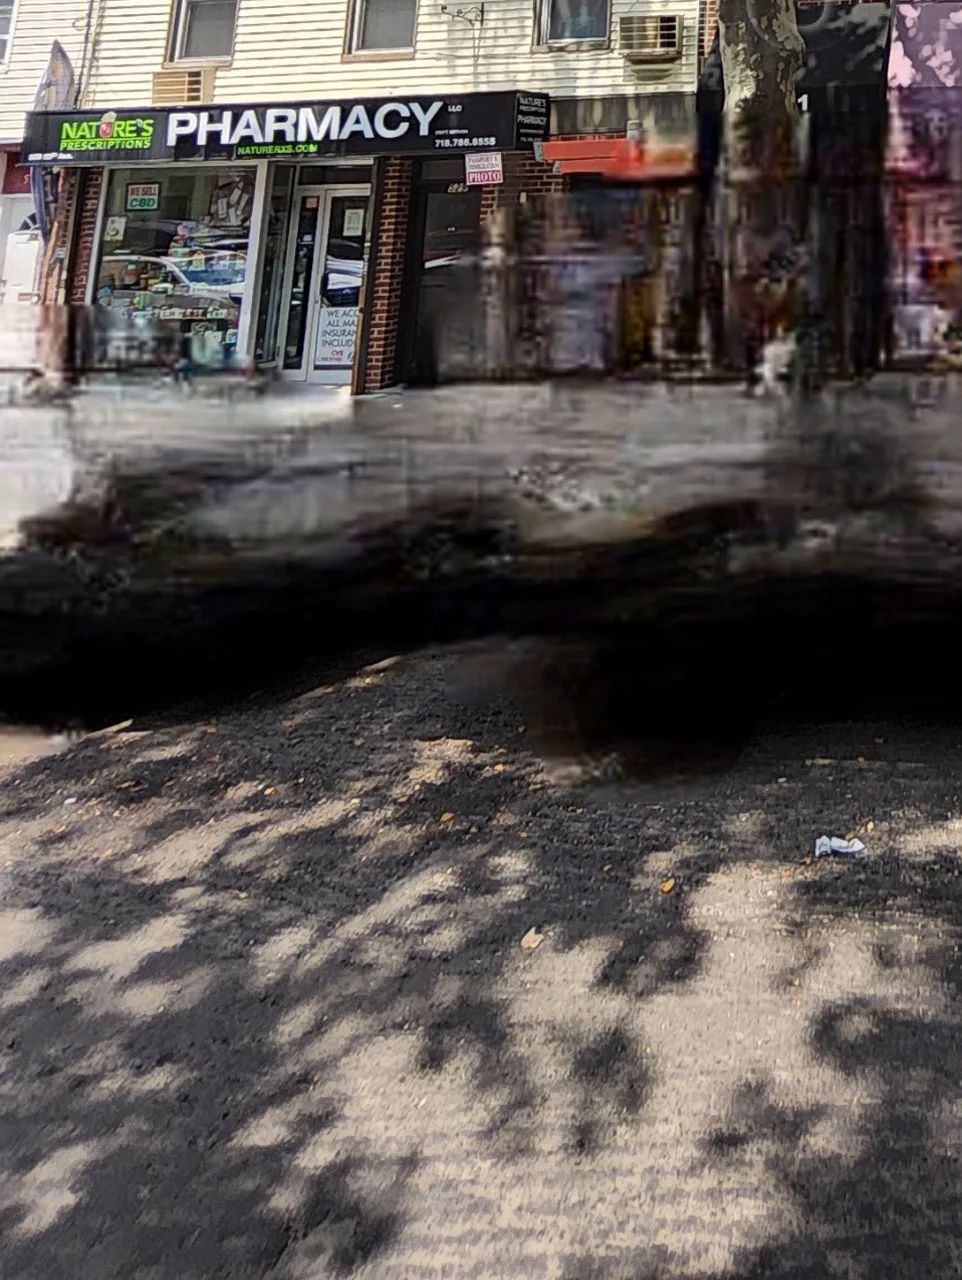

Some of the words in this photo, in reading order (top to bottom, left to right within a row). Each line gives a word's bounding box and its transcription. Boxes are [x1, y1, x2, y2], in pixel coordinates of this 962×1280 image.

[61, 118, 154, 139] NATURE'S
[167, 101, 443, 147] PHARMACY
[60, 139, 151, 151] PRESCRIPTIONS
[469, 171, 500, 182] PHOTO
[130, 198, 156, 208] CBD
[326, 319, 340, 328] ALL
